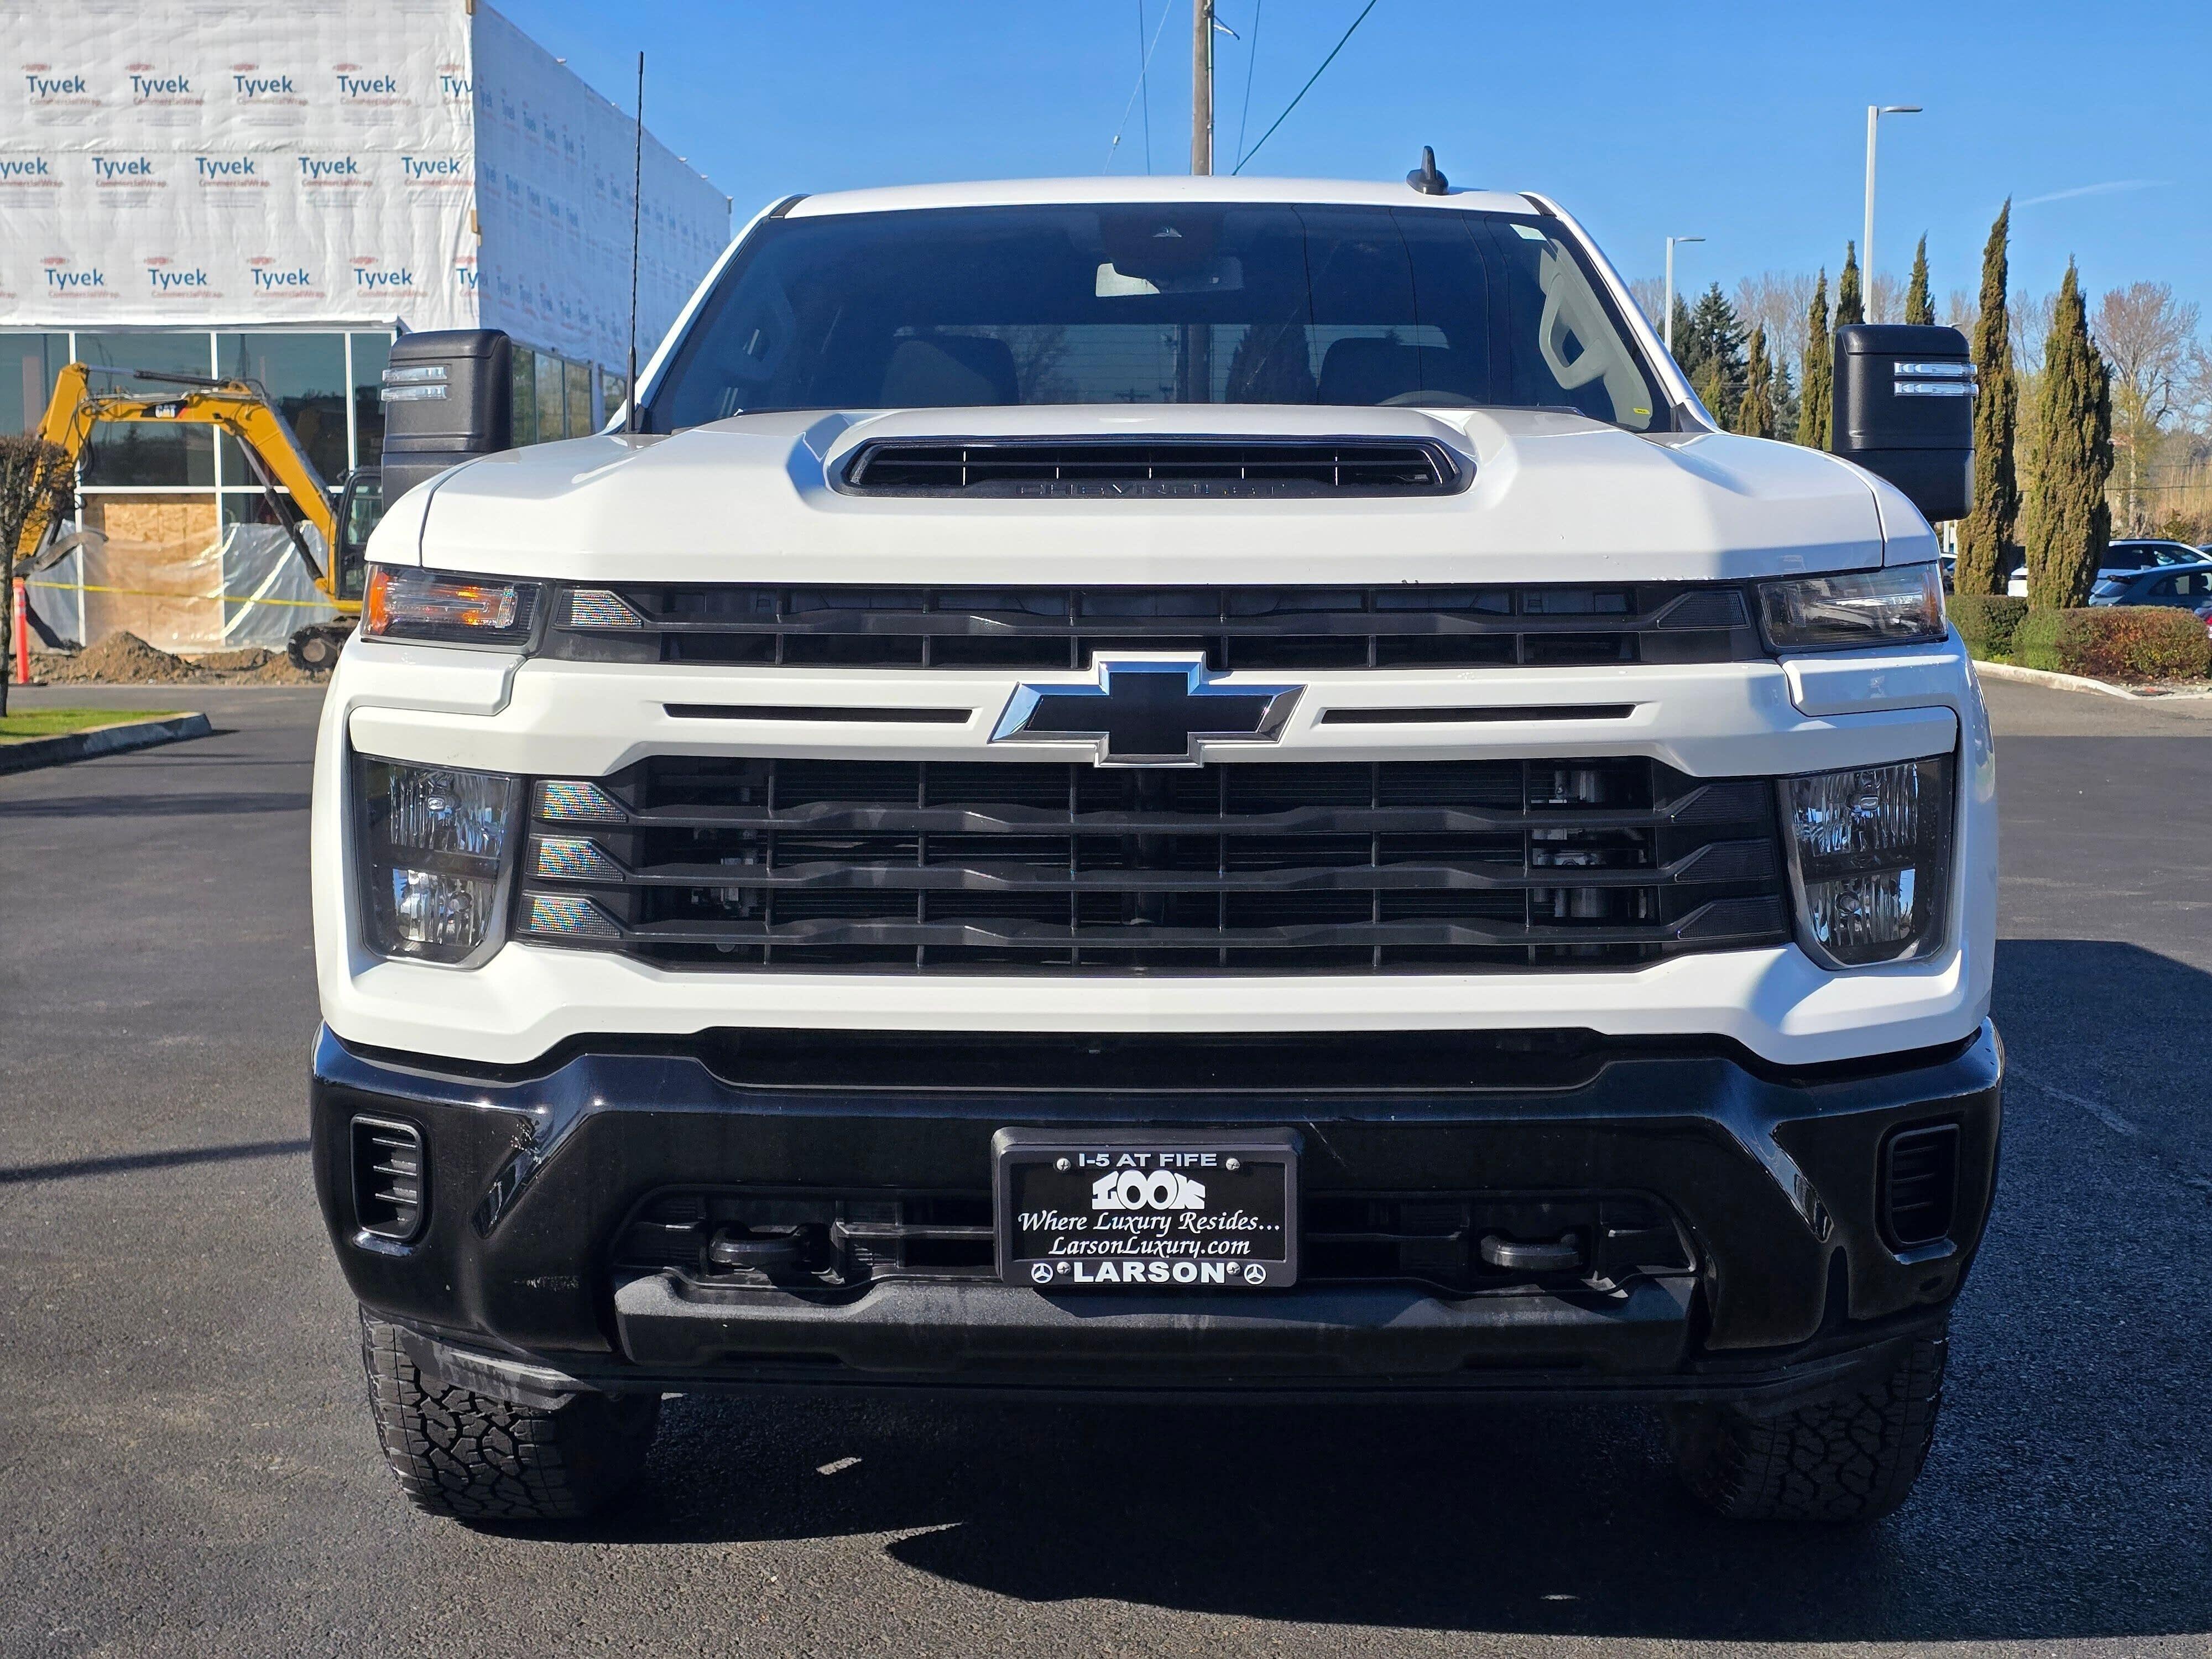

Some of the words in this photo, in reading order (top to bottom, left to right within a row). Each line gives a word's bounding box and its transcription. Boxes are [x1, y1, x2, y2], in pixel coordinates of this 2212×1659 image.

[26, 75, 86, 97] Tyvek
[129, 75, 189, 97] Tyvek
[233, 75, 293, 97] Tyvek
[337, 75, 396, 97] Tyvek
[440, 75, 473, 97] Tyv
[0, 157, 48, 179] yvek
[92, 157, 151, 179] Tyvek
[195, 157, 254, 179] Tyvek
[299, 156, 357, 179] Tyvek
[401, 157, 461, 179] Tyvek
[45, 268, 104, 290] Tyvek
[148, 268, 207, 290] Tyvek
[251, 268, 310, 290] Tyvek
[354, 268, 413, 290] Tyvek
[155, 404, 176, 418] CAT
[1079, 1153, 1110, 1167] I-5
[1116, 1153, 1151, 1167] AT
[1159, 1153, 1217, 1167] FIFE
[1018, 1209, 1088, 1231] Where
[1092, 1212, 1172, 1238] Luxury
[1177, 1209, 1280, 1234] Resides...
[1048, 1236, 1251, 1259] LarsonLuxury.com
[1073, 1261, 1225, 1284] LARSON
